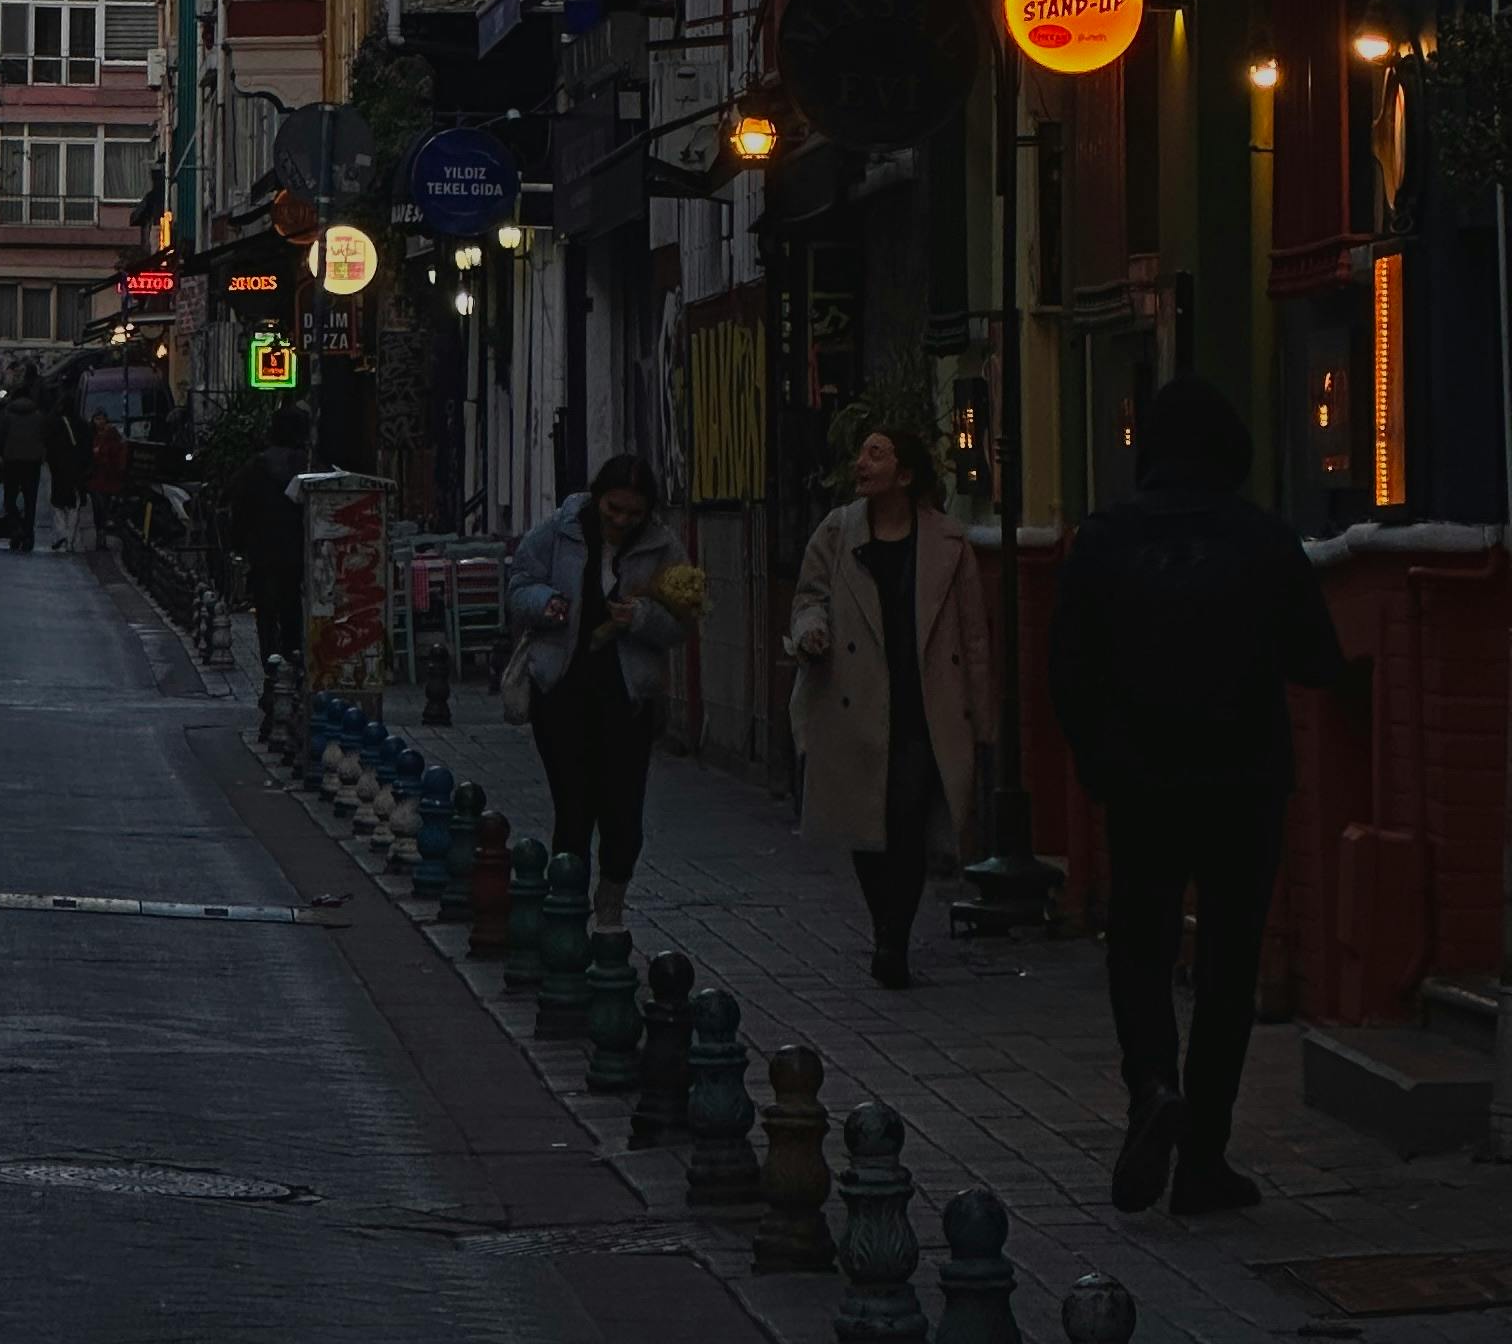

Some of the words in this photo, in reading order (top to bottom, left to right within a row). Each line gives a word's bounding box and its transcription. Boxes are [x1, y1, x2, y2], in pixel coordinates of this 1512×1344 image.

[443, 166, 487, 180] YILDIZ
[426, 182, 469, 195] TEKEL
[471, 183, 503, 196] GIDA
[124, 277, 174, 290] ATTOO
